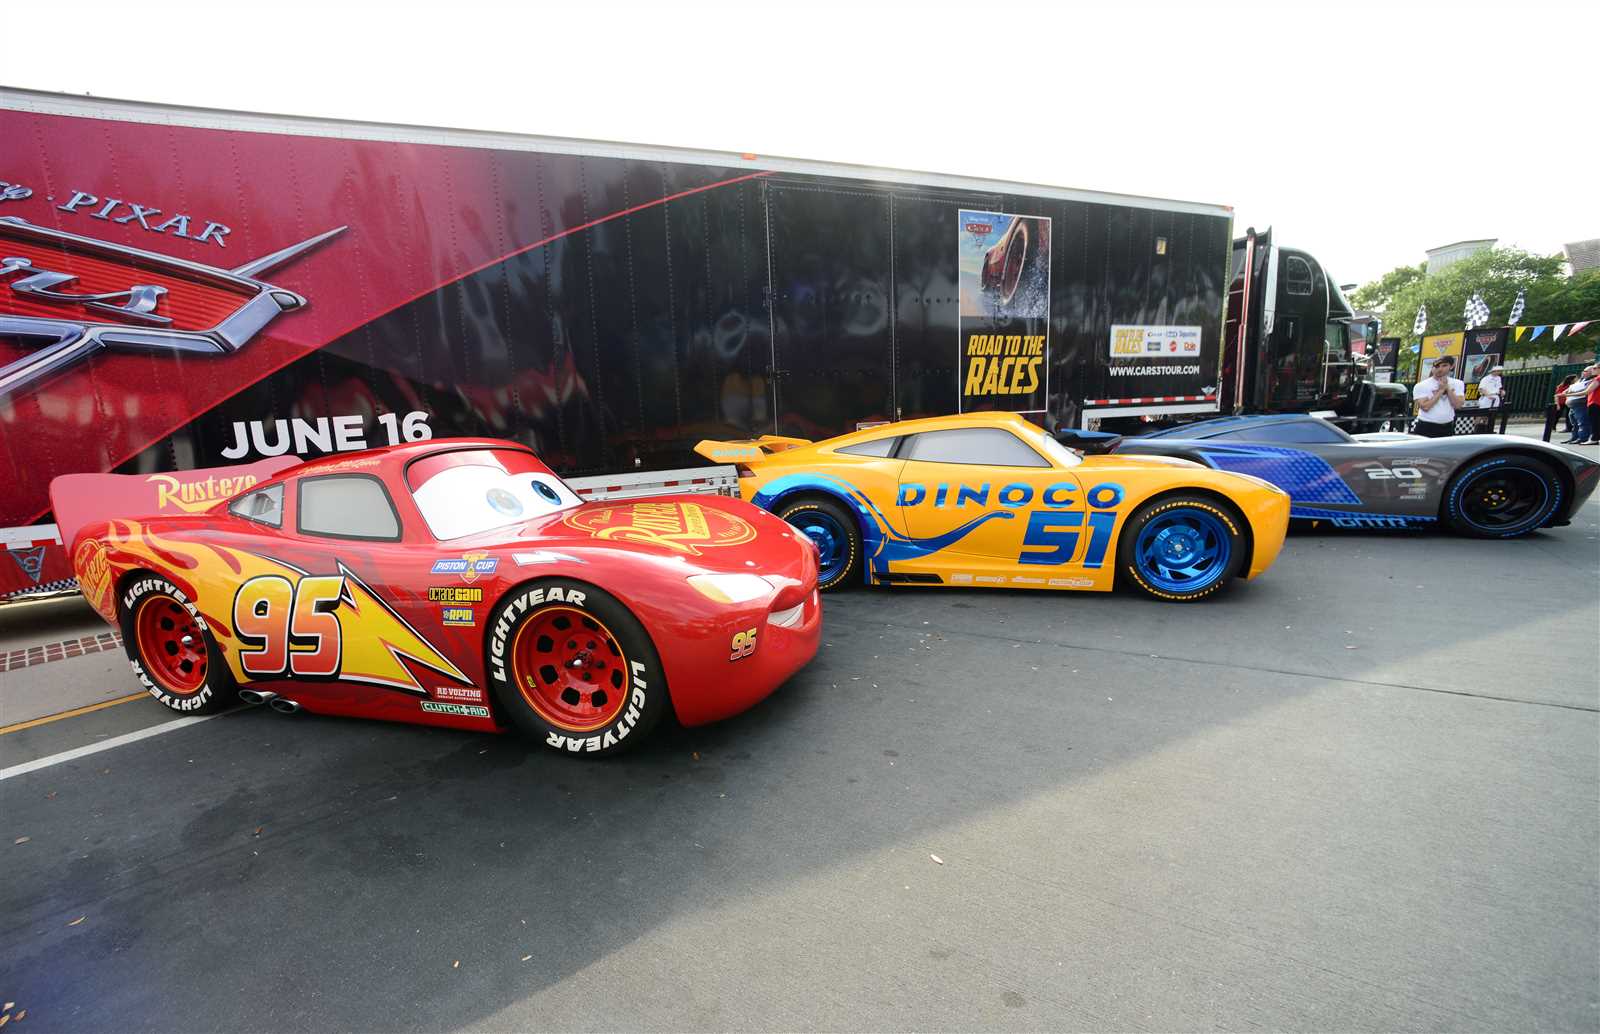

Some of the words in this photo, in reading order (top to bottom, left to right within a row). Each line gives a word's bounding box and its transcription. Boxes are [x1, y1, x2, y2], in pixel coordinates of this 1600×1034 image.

[57, 190, 231, 248] PIXAR
[967, 335, 1002, 356] ROAD
[1004, 336, 1022, 355] TO
[1022, 336, 1045, 355] THE
[964, 357, 1043, 396] RACES
[1109, 365, 1200, 376] WWW.CARS3TOUR.COM
[221, 415, 367, 459] JUNE
[378, 410, 433, 447] 16
[895, 482, 1125, 509] DINOCO
[1364, 468, 1422, 480] 20
[1018, 511, 1117, 568] 51
[435, 561, 467, 570] PISTON
[475, 560, 495, 570] CUP
[123, 579, 208, 632] LIGHTYEAR
[233, 575, 345, 680] 95
[491, 587, 587, 683] LIGHTYEAR
[731, 628, 757, 659] 95
[130, 659, 213, 711] LIGHTYEAR
[546, 659, 648, 752] LIGHTYEAR
